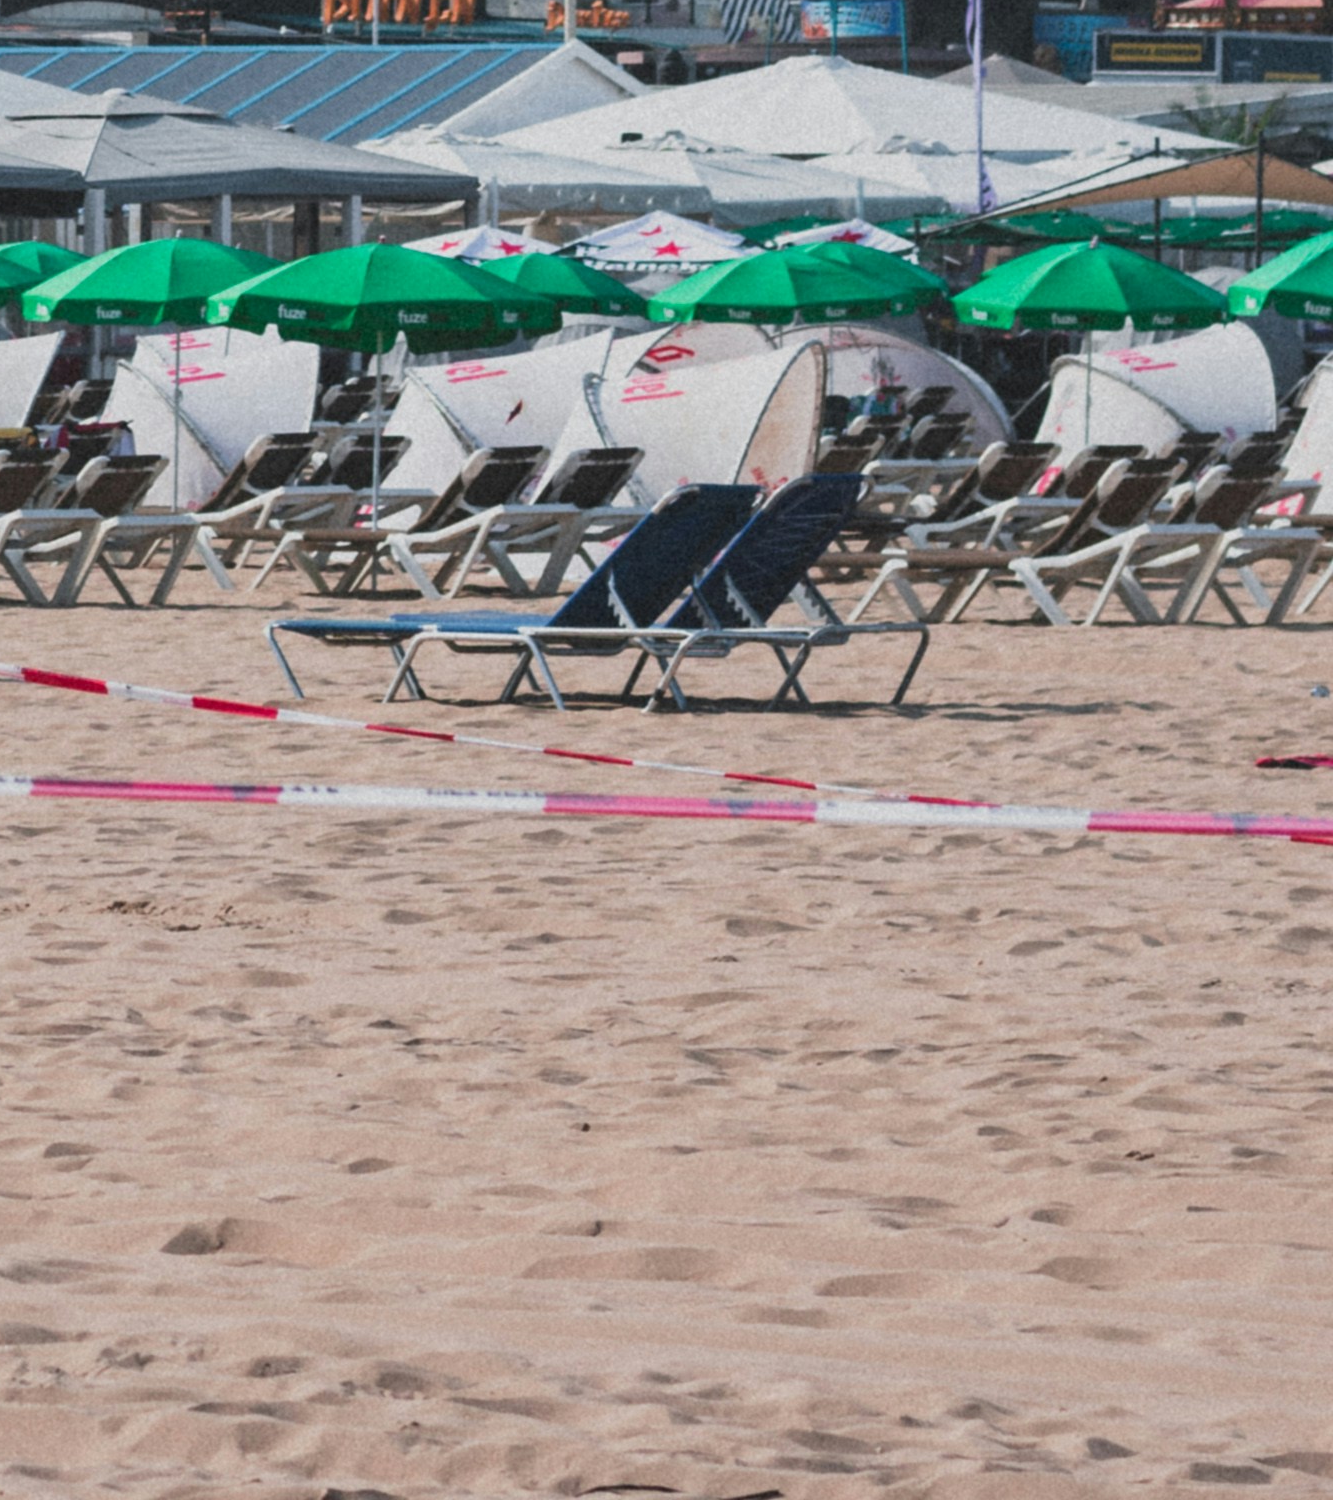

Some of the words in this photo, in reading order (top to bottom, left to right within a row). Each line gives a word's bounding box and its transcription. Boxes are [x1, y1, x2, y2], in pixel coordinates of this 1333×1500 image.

[96, 306, 122, 319] fuze
[278, 304, 306, 319] fuze
[398, 310, 428, 323] fuze
